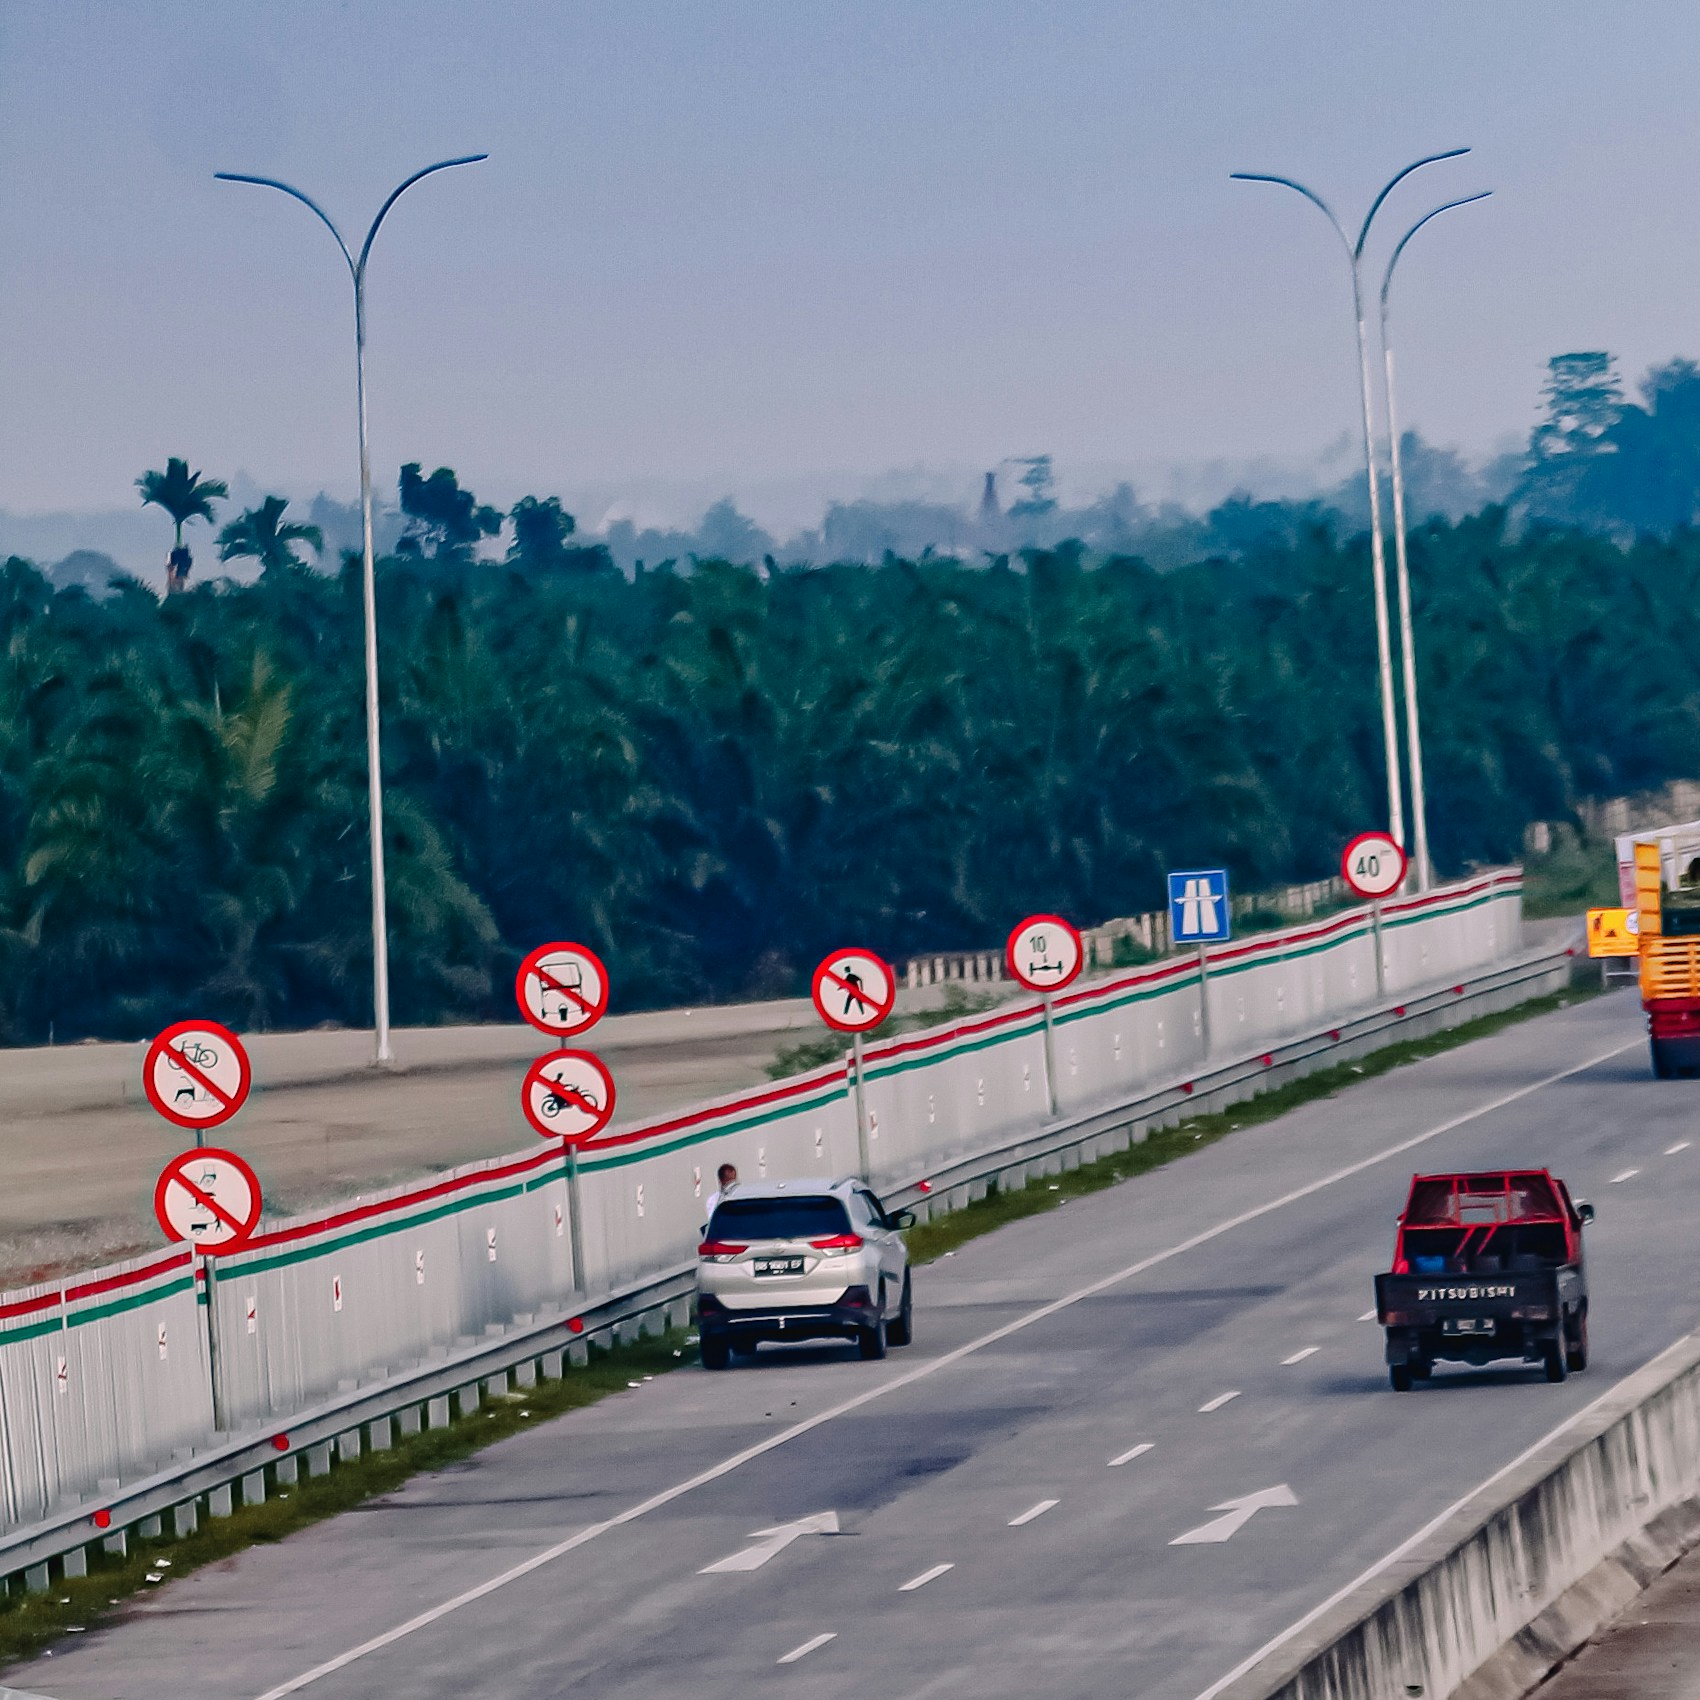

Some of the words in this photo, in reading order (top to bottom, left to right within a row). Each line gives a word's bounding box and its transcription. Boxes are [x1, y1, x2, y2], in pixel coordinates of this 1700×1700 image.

[1355, 855, 1380, 878] 40
[1029, 936, 1047, 953] 10
[1418, 1286, 1516, 1300] MITSUBISHI
